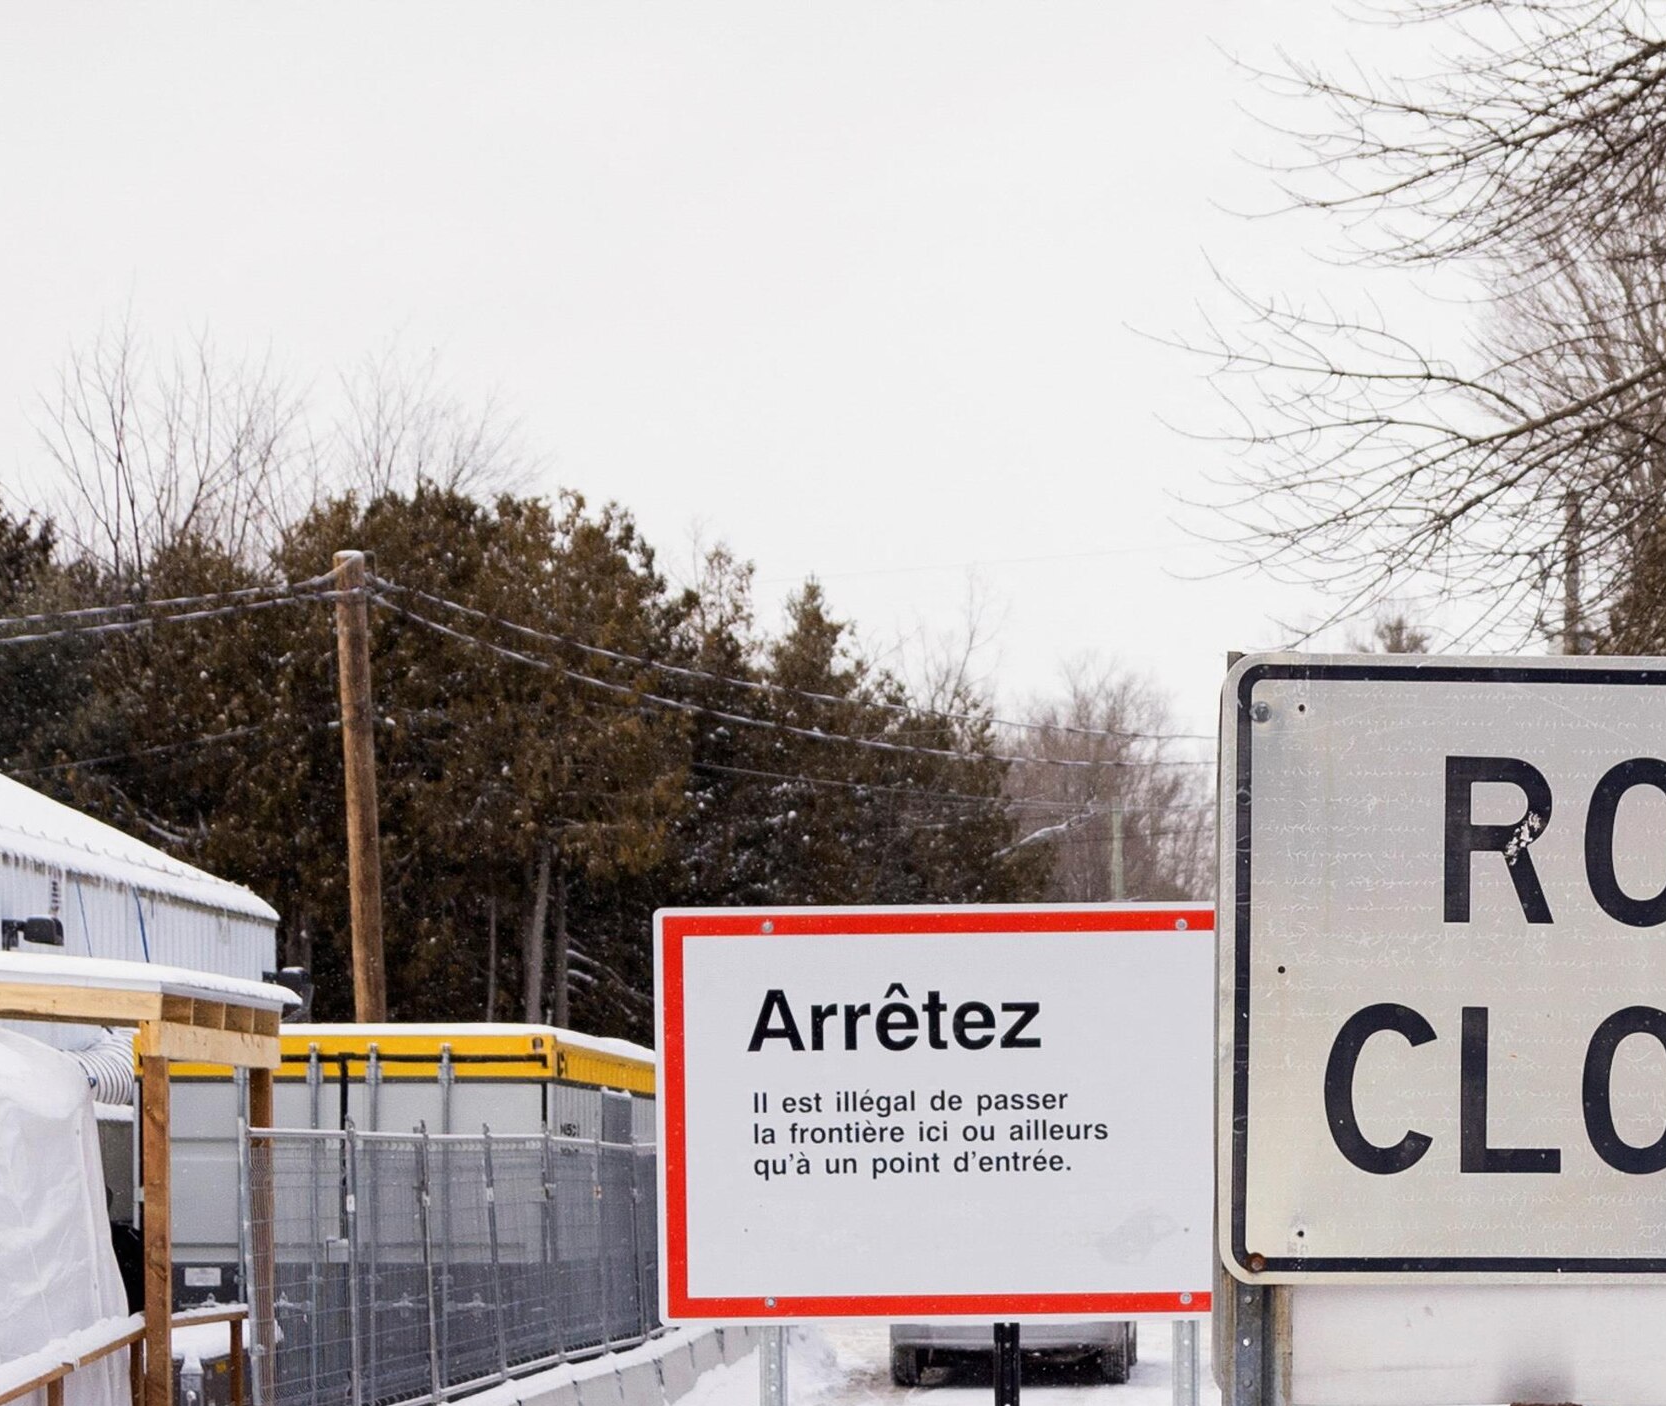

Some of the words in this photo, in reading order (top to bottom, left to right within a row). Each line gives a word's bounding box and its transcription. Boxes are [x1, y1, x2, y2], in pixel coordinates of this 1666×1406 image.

[747, 982, 1042, 1052] Arrêtez
[753, 1092, 768, 1114] Il
[782, 1092, 823, 1114] est
[836, 1089, 916, 1118] illégal
[929, 1089, 963, 1112] de
[977, 1093, 1068, 1117] passer
[753, 1123, 776, 1145] la
[789, 1120, 905, 1144] frontière
[919, 1120, 948, 1143] ici
[962, 1125, 995, 1142] ou
[1009, 1119, 1109, 1142] ailleurs
[825, 1157, 857, 1175] un
[872, 1151, 940, 1180] point
